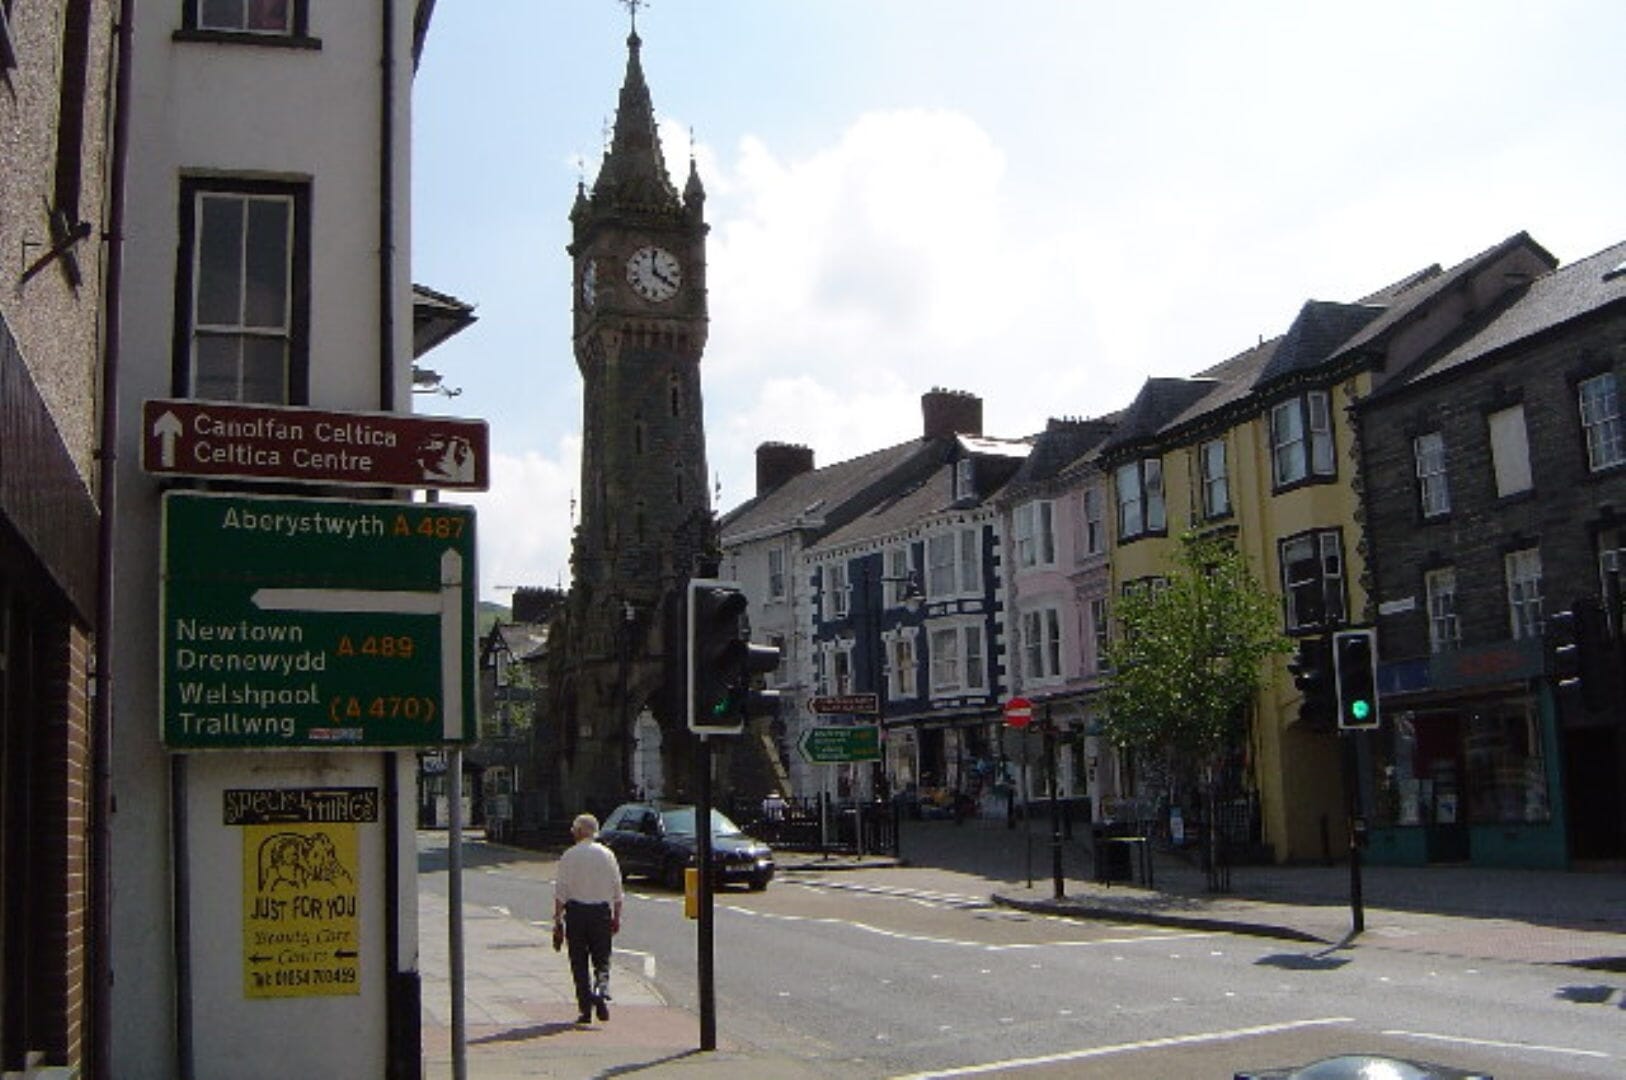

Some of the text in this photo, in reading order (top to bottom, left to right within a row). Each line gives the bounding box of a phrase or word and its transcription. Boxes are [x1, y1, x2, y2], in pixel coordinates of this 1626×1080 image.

[194, 413, 397, 448] Canolfan Celtica
[194, 441, 372, 472] Celtica Centre
[222, 506, 385, 540] Aberystwyth
[176, 618, 303, 643] Newtown
[176, 648, 326, 676] Drenewydd
[179, 681, 320, 709] Welshpool
[179, 712, 295, 738] Trallwng
[251, 895, 356, 921] JUST FOR YOU
